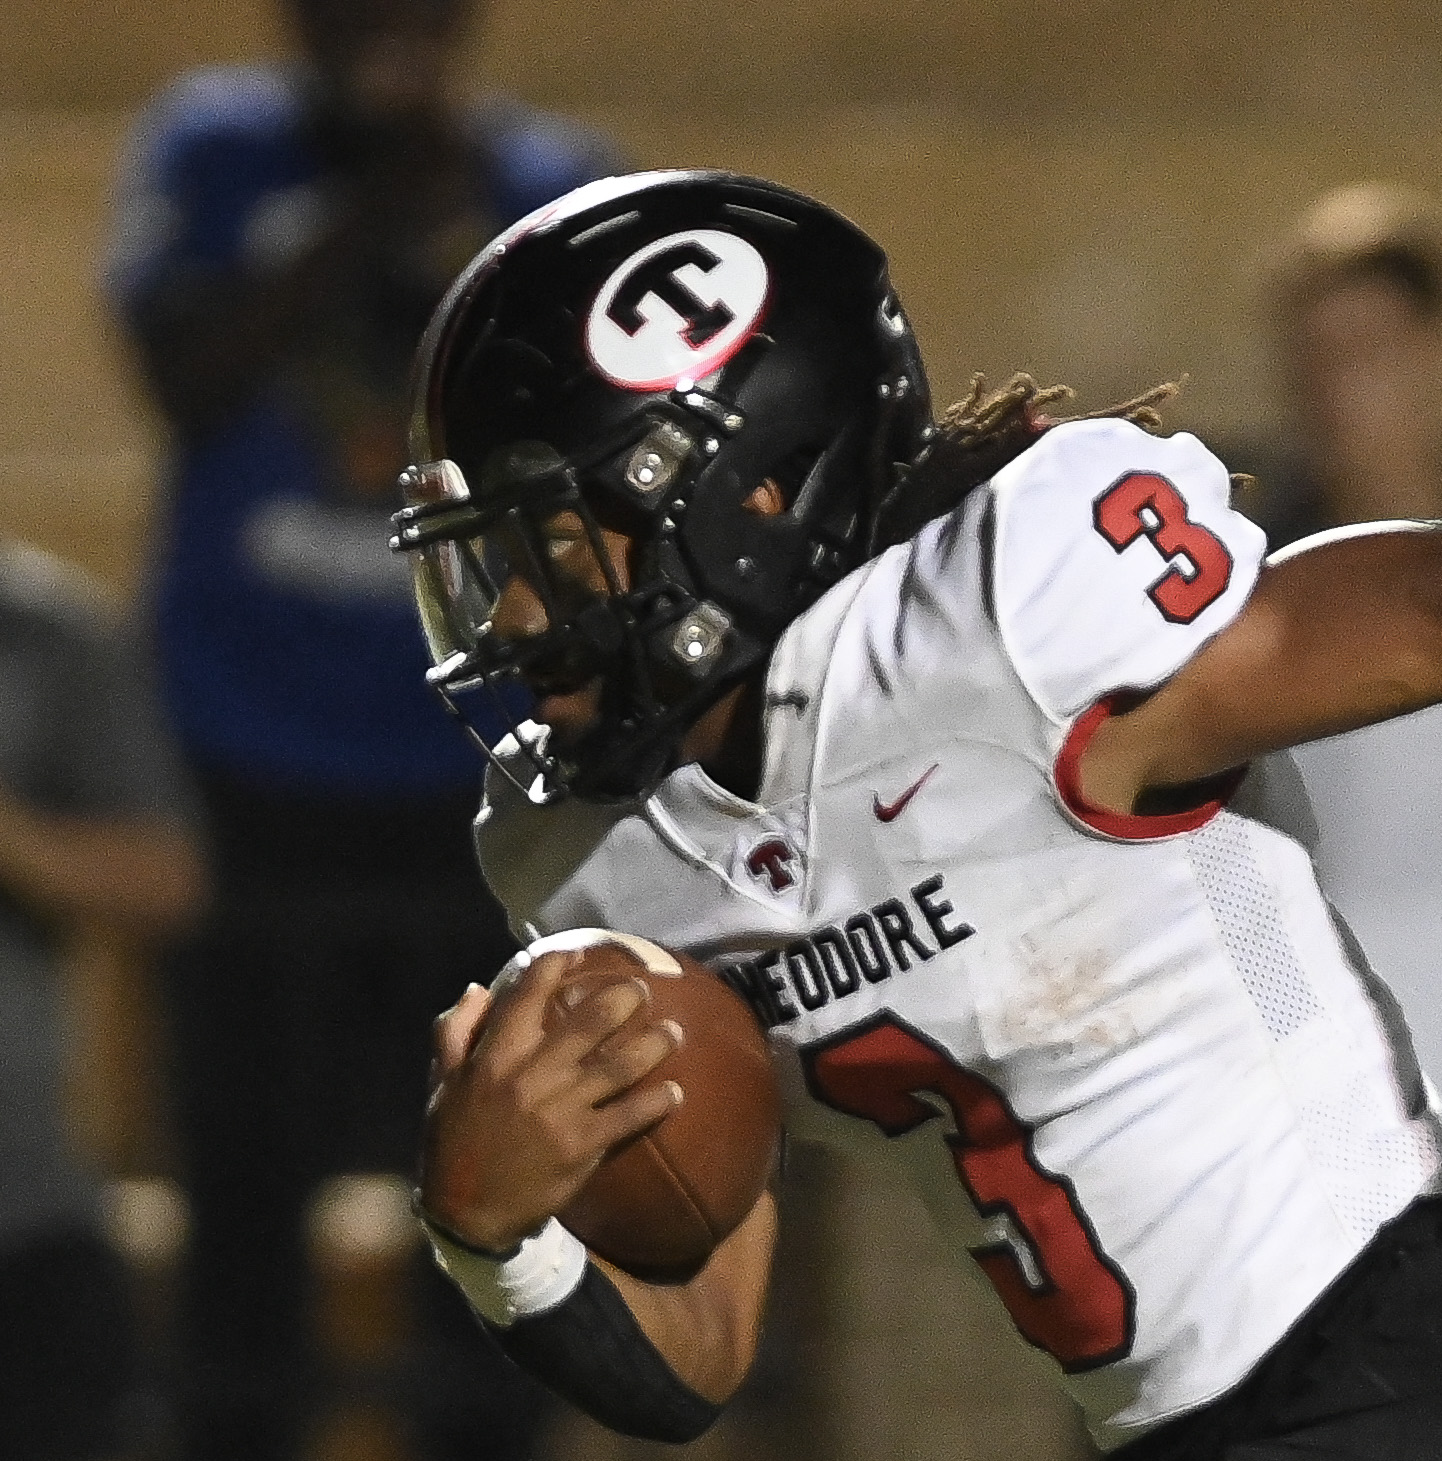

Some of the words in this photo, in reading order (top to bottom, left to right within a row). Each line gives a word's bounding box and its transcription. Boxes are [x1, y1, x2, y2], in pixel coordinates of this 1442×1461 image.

[605, 239, 736, 350] T
[1092, 469, 1232, 622] 3
[746, 840, 795, 890] T
[800, 1006, 1138, 1374] 3
